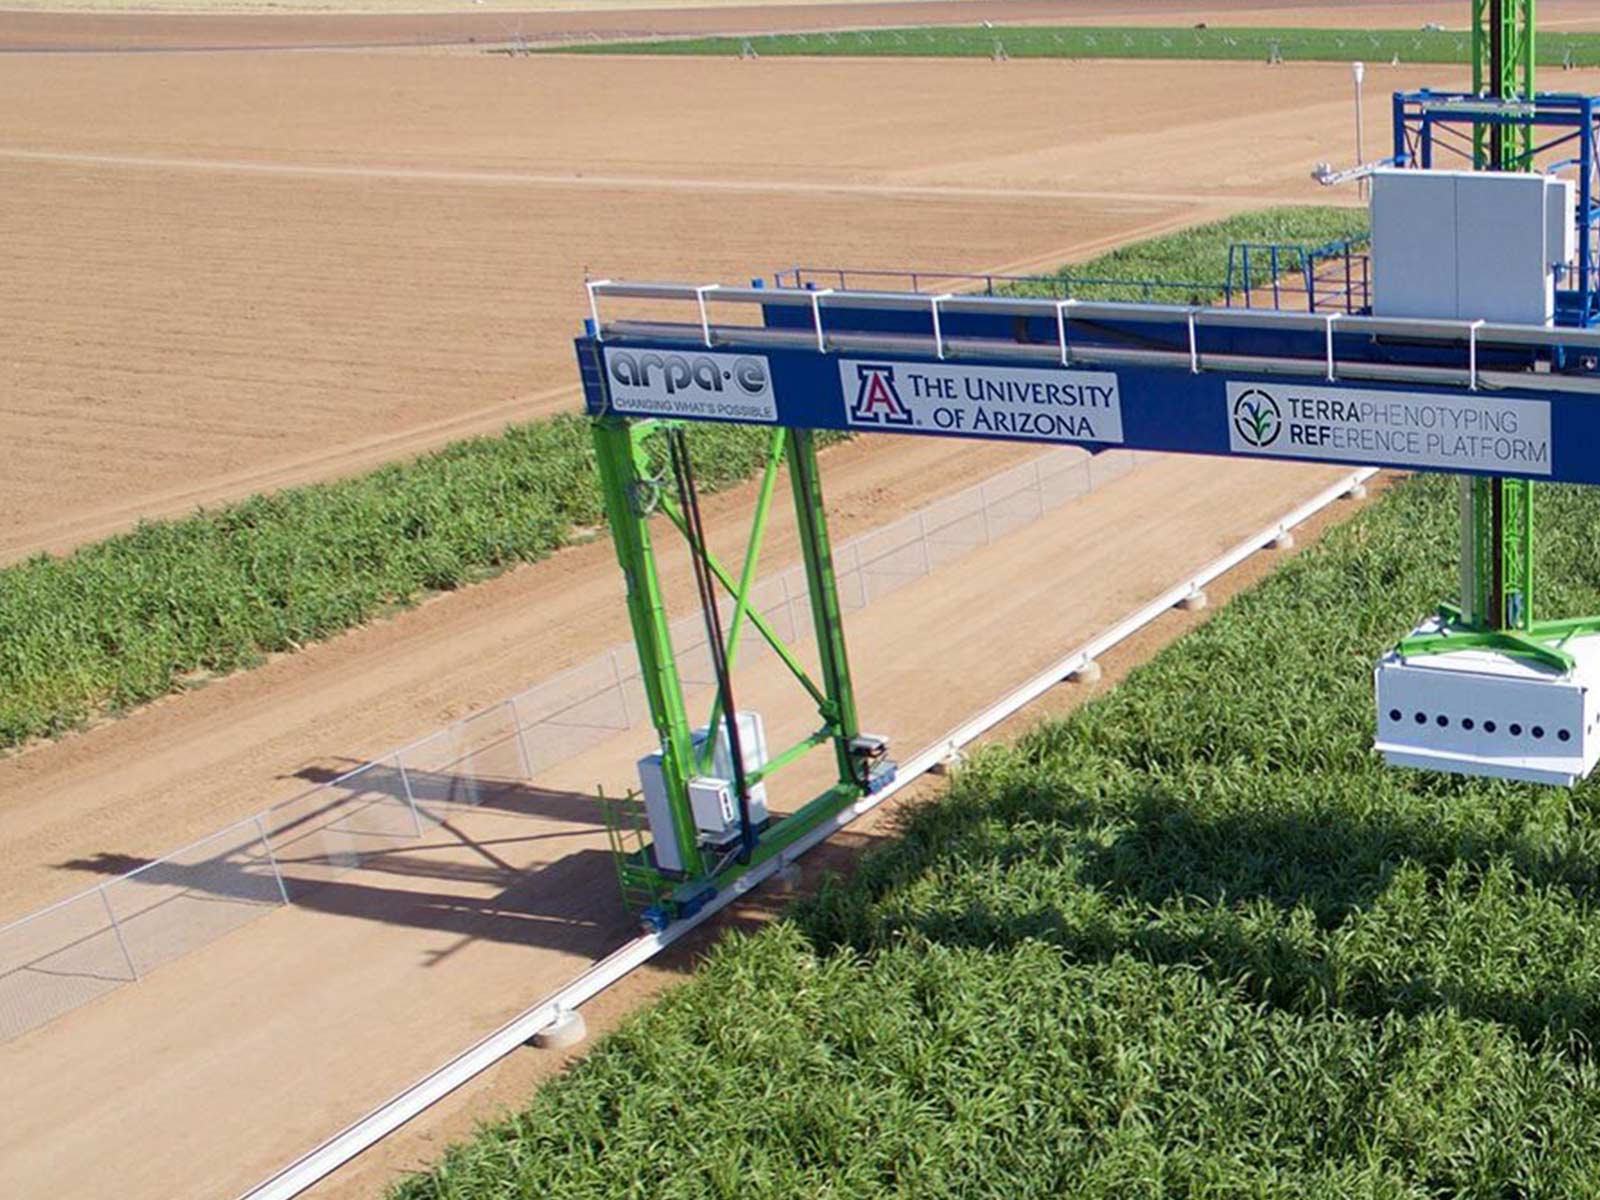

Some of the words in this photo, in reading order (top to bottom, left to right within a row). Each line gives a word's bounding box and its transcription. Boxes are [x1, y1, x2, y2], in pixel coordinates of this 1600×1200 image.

[615, 397, 672, 411] CHANGING
[675, 401, 716, 414] WHAT'S
[718, 404, 772, 418] POSSIBLE
[851, 364, 913, 425] A
[908, 374, 958, 399] THE
[966, 378, 1114, 408] UNIVERSITY
[933, 407, 965, 429] OF
[973, 406, 1095, 437] ARIZONA
[1290, 424, 1420, 454] REFERENCE
[1427, 433, 1547, 462] PLATFORM
